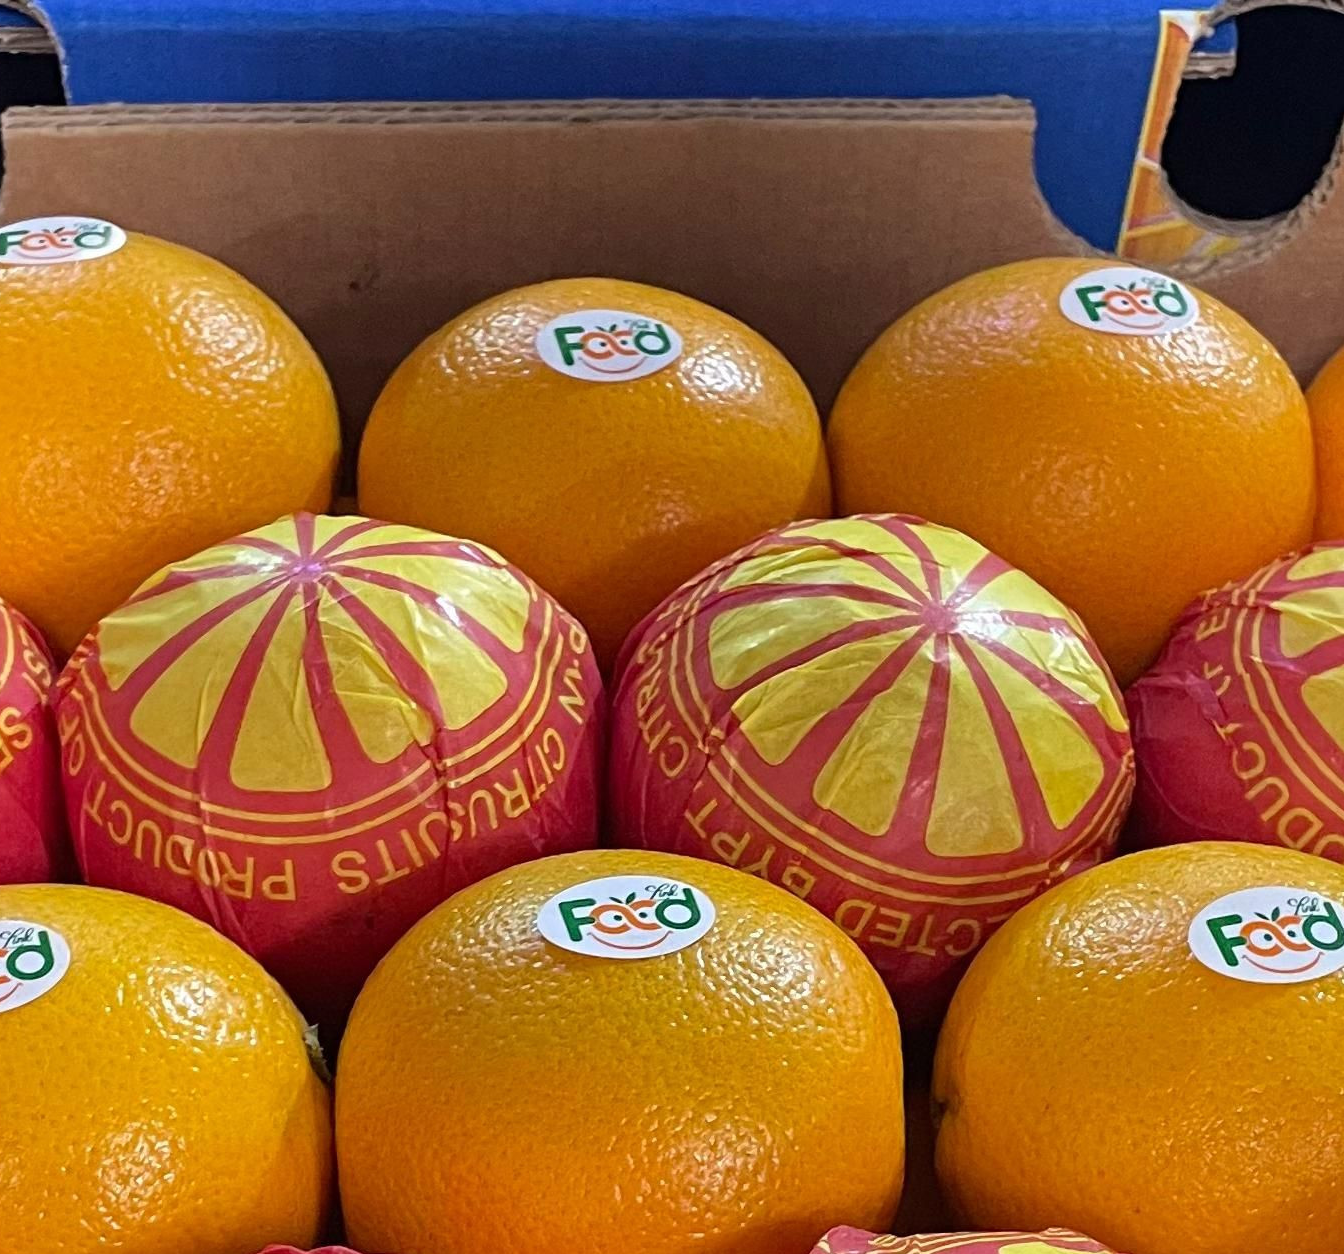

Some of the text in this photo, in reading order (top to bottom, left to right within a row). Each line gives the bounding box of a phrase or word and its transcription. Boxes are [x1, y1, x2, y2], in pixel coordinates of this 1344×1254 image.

[1075, 282, 1188, 322] Food
[554, 323, 672, 366] Food
[558, 887, 701, 942] Food
